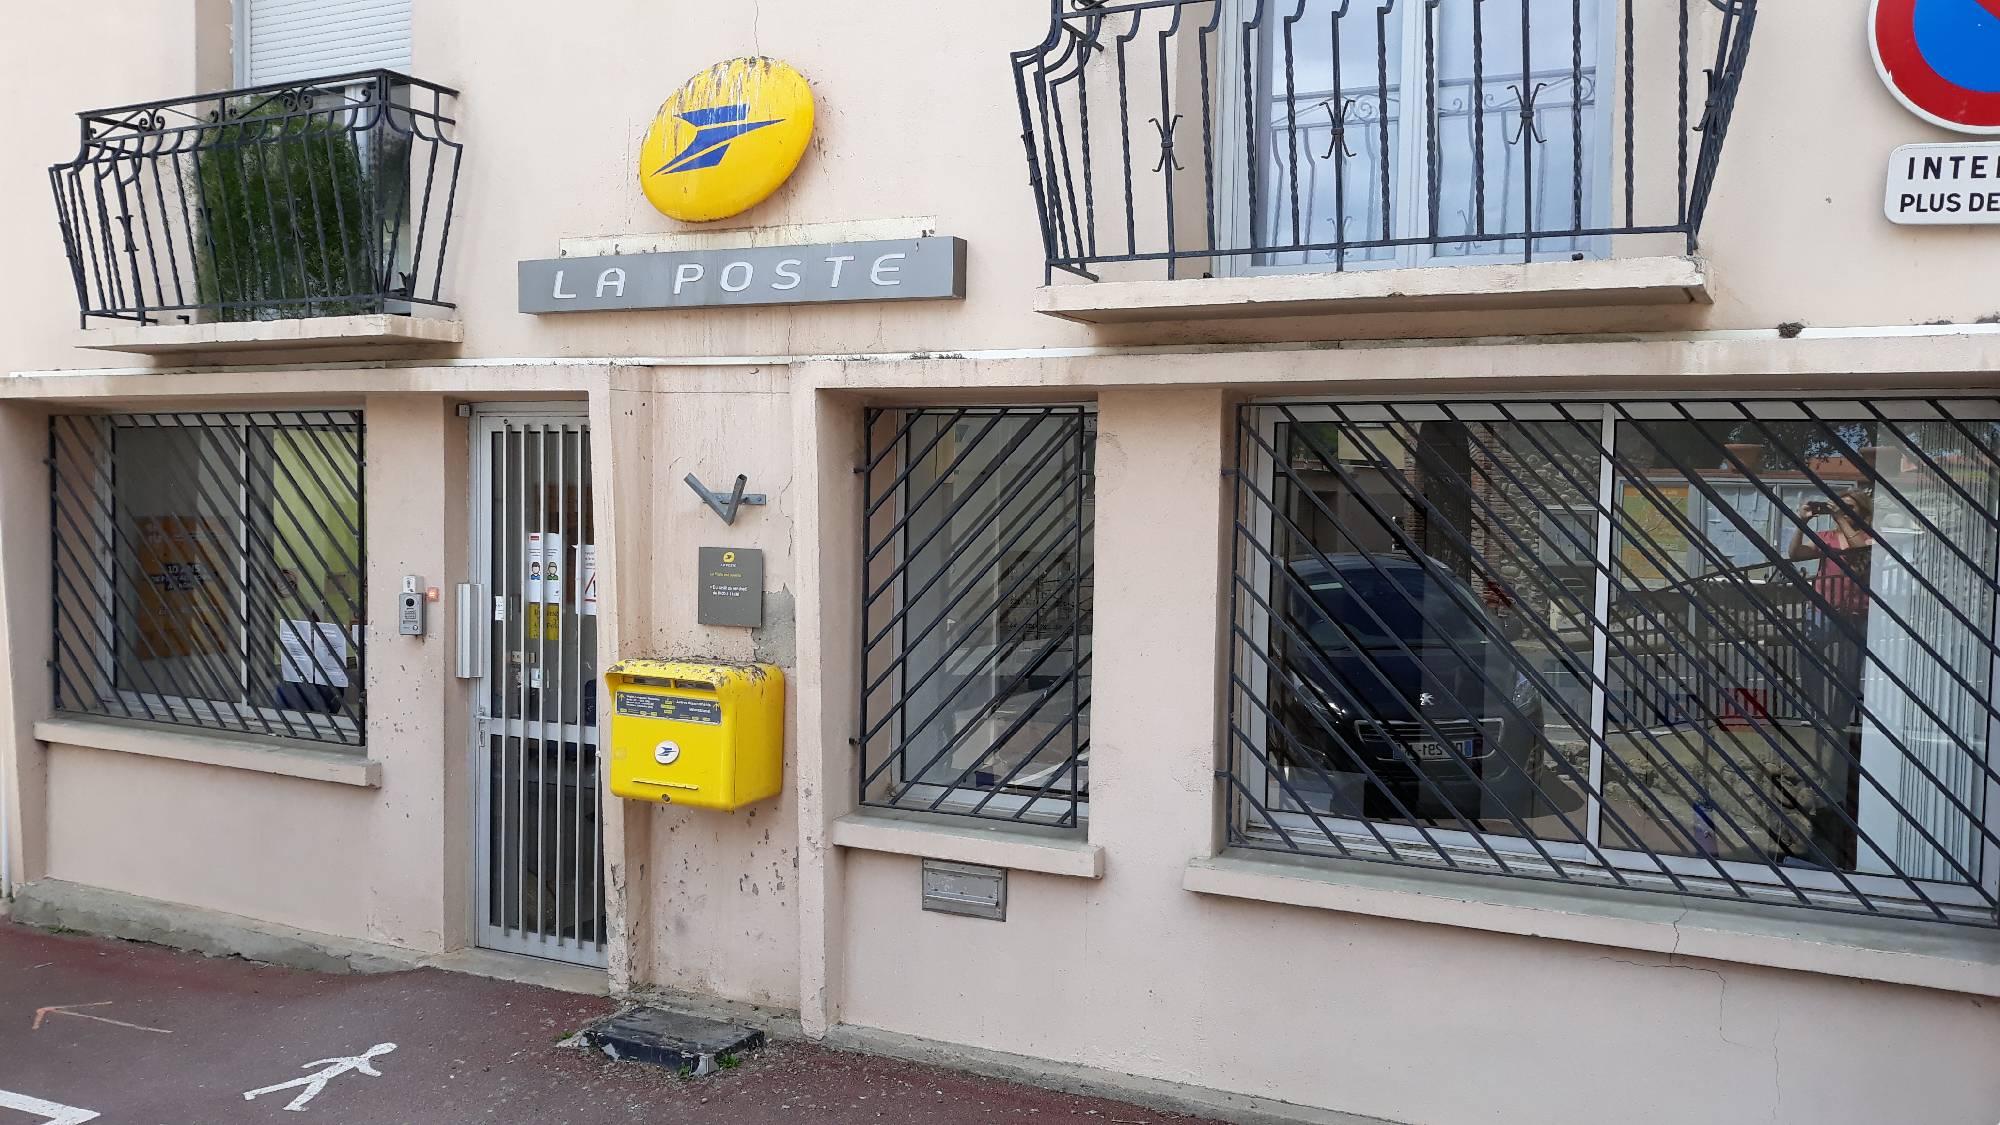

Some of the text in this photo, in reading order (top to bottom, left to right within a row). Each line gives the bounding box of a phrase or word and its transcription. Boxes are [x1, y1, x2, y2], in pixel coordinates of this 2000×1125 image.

[1907, 155, 2000, 180] INTE
[1899, 192, 2000, 213] PLUS DE
[552, 252, 907, 300] LA POSTE
